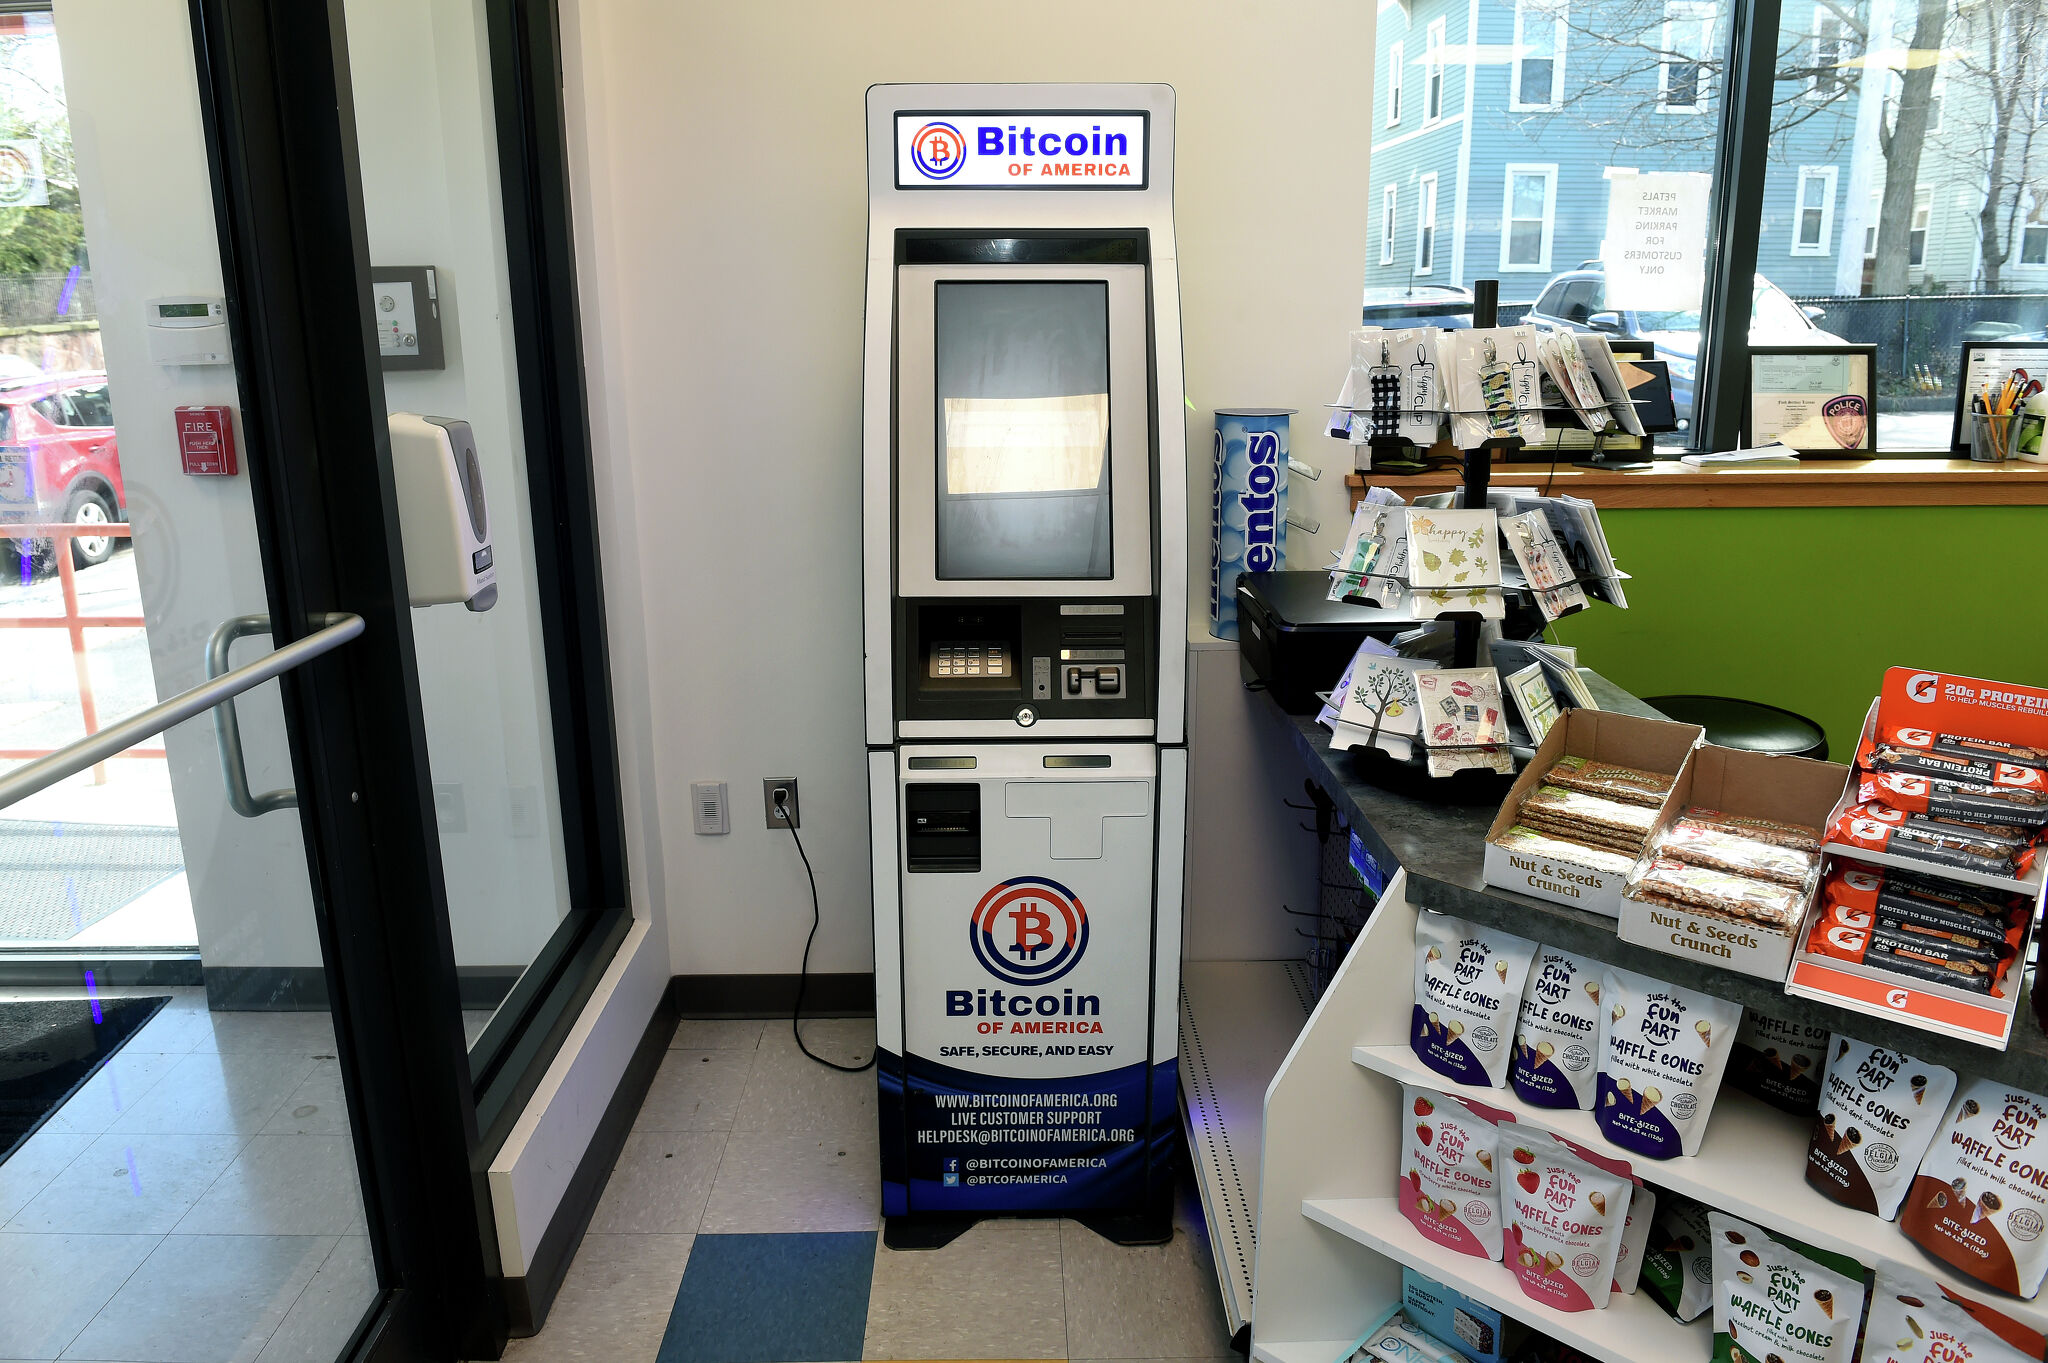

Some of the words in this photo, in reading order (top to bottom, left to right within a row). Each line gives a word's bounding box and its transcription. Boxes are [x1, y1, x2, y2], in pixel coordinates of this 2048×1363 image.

[977, 126, 1127, 156] Bitcoin
[1008, 163, 1033, 176] OF
[1041, 163, 1131, 176] AMERICA
[1829, 401, 1861, 416] POLICE
[184, 422, 213, 431] FIRE
[1238, 431, 1280, 572] entos
[1429, 524, 1467, 542] happy
[1958, 697, 1977, 705] HELP
[1979, 700, 2016, 711] MUSCLES
[1940, 733, 1986, 744] PROTEIN
[1918, 757, 1941, 767] BAR
[1944, 762, 1990, 776] PROTEIN
[1931, 806, 1961, 816] PROTEIN
[1994, 814, 2026, 823] MUSCLES
[1510, 856, 1537, 872] Nut
[1541, 865, 1553, 876] &
[1557, 868, 1602, 888] Seeds
[1527, 875, 1580, 898] Crunch
[1650, 912, 1682, 929] Nut
[1687, 922, 1701, 934] &
[1705, 926, 1758, 948] Seeds
[1880, 904, 1908, 916] PROTEIN
[1920, 914, 1938, 923] HELP
[1940, 918, 1971, 932] MUSCLES
[1972, 928, 2002, 940] REBUILD
[1460, 940, 1479, 948] Just
[1480, 943, 1491, 955] the
[1671, 933, 1732, 958] Crunch
[1874, 936, 1921, 954] PROTEIN
[1924, 950, 1949, 959] BAR
[1453, 962, 1483, 980] PART
[1544, 955, 1563, 963] Just
[1565, 960, 1577, 974] the
[1424, 972, 1462, 998] WAFFLE
[1463, 991, 1499, 1010] CONES
[1536, 979, 1570, 1000] PART
[946, 989, 1100, 1016] Bitcoin
[1434, 997, 1445, 1005] with
[1447, 1003, 1461, 1012] white
[1464, 1008, 1491, 1020] chocolate
[1647, 993, 1670, 1003] Just
[1671, 997, 1687, 1013] the
[1521, 1000, 1548, 1020] FFLE
[1552, 1011, 1594, 1031] CONES
[1749, 1012, 1800, 1036] WAFFLE
[1805, 1027, 1831, 1040] CON
[977, 1022, 1003, 1034] OF
[1010, 1021, 1103, 1034] AMERICA
[1523, 1019, 1533, 1027] with
[1554, 1029, 1583, 1040] chocolate
[1641, 1018, 1680, 1042] PART
[939, 1046, 979, 1058] SAFE,
[982, 1045, 1043, 1058] SECURE,
[1045, 1045, 1075, 1056] AND
[1079, 1045, 1114, 1056] EASY
[1431, 1043, 1463, 1061] BITE-SIZED
[1789, 1039, 1805, 1047] dark
[1563, 1053, 1590, 1062] CHOCOLATE
[1609, 1034, 1657, 1062] WAFFLE
[1661, 1054, 1704, 1075] CONES
[1518, 1067, 1553, 1084] BITE-SIZED
[1611, 1055, 1624, 1066] filled
[1625, 1061, 1640, 1070] with
[1642, 1068, 1660, 1077] white
[1662, 1074, 1693, 1087] chocolate
[1856, 1062, 1894, 1090] PART
[935, 1094, 1118, 1108] WWW.BITCOINOFAMERICA.ORG
[1828, 1072, 1865, 1106] WAFFLE
[1867, 1100, 1910, 1130] CONES
[2004, 1093, 2030, 1106] Just
[2032, 1104, 2047, 1120] the
[951, 1112, 976, 1126] LIVE
[979, 1111, 1044, 1125] CUSTOMER
[1046, 1111, 1102, 1125] SUPPORT
[1619, 1112, 1660, 1133] BITE-SIZED
[1836, 1101, 1848, 1112] with
[1849, 1108, 1863, 1121] dark
[1864, 1120, 1895, 1139] chocolate
[918, 1129, 1134, 1145] HELPDESK@BITCOINOFAMERICA.ORG
[1440, 1122, 1458, 1130] Just
[1459, 1129, 1470, 1142] the
[1992, 1119, 2035, 1146] PART
[1436, 1143, 1464, 1163] PART
[1814, 1147, 1848, 1176] BITE-SIZED
[1864, 1148, 1899, 1162] BELGIAN
[1952, 1131, 2007, 1168] WAFFLE
[2009, 1160, 2048, 1190] CONE
[966, 1158, 1107, 1170] @BITCOINOFAMERICA
[1414, 1148, 1450, 1177] WAFFLE
[1454, 1171, 1492, 1189] CONES
[967, 1174, 1068, 1186] @BTCOFAMERICA
[1568, 1172, 1581, 1185] the
[1957, 1156, 1971, 1169] filled
[1972, 1165, 1988, 1177] with
[1990, 1173, 2006, 1185] milk
[2008, 1183, 2046, 1204] chocolate
[1544, 1188, 1576, 1209] PART
[1464, 1207, 1492, 1217] BELGIAN
[1514, 1199, 1559, 1228] WAFFLE
[1562, 1221, 1603, 1236] CONES
[2008, 1212, 2044, 1233] BELGIAN
[1423, 1214, 1458, 1233] BITE-SIZED
[1942, 1216, 1987, 1246] BITE-SIZED
[1520, 1221, 1548, 1239] strawberry
[1549, 1235, 1564, 1244] white
[1565, 1239, 1591, 1248] chocolate
[1526, 1269, 1564, 1289] BITE-SIZED
[1791, 1269, 1806, 1285] the
[1767, 1286, 1801, 1310] PART
[1731, 1294, 1783, 1330] WAFFLE
[1785, 1323, 1833, 1347] CONES
[1732, 1316, 1754, 1334] hazelnut
[1754, 1329, 1773, 1341] cream
[1773, 1339, 1780, 1347] &
[1781, 1343, 1795, 1351] milk
[1796, 1348, 1825, 1361] chocolate
[1929, 1330, 1956, 1343] Just
[1957, 1341, 1974, 1358] the
